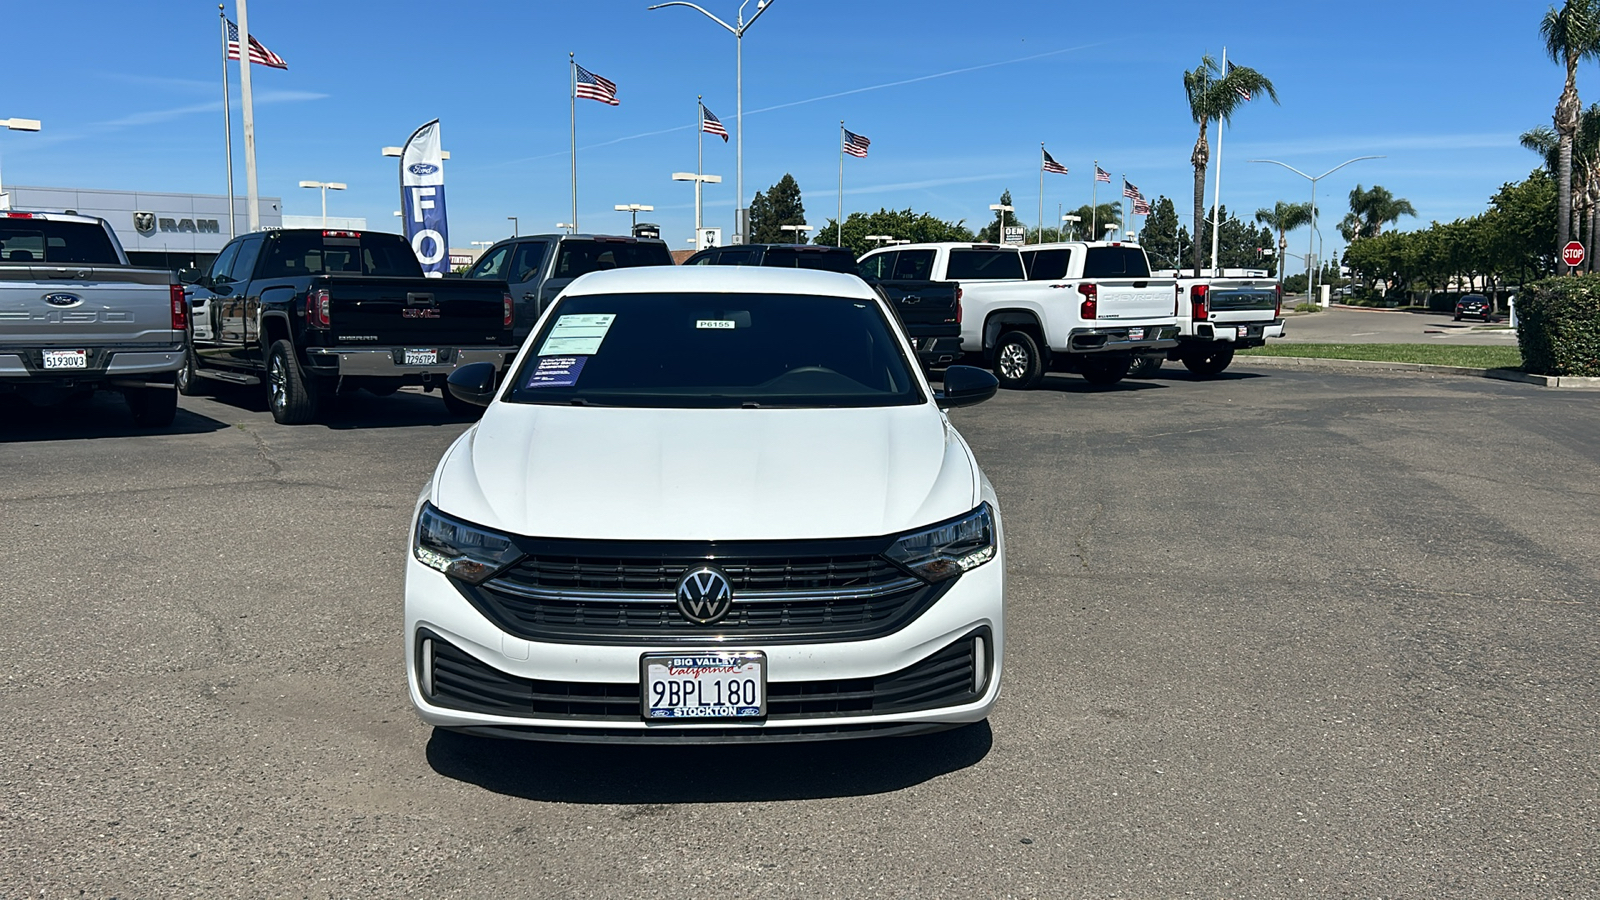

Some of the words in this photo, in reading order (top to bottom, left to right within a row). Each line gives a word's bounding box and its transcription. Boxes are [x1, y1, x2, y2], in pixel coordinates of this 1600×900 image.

[411, 163, 435, 175] Ford
[158, 217, 219, 233] RAM
[411, 187, 444, 278] FO
[1005, 227, 1024, 235] OEM
[1564, 249, 1583, 259] STOP
[1103, 292, 1172, 302] CHEVROLET
[402, 308, 441, 319] GMC
[46, 356, 84, 367] 51930V3
[673, 658, 693, 666] BIG
[695, 658, 736, 666] VALLEY
[669, 665, 743, 679] California
[652, 679, 756, 707] 9BPL180
[673, 706, 738, 717] STOCKTON
